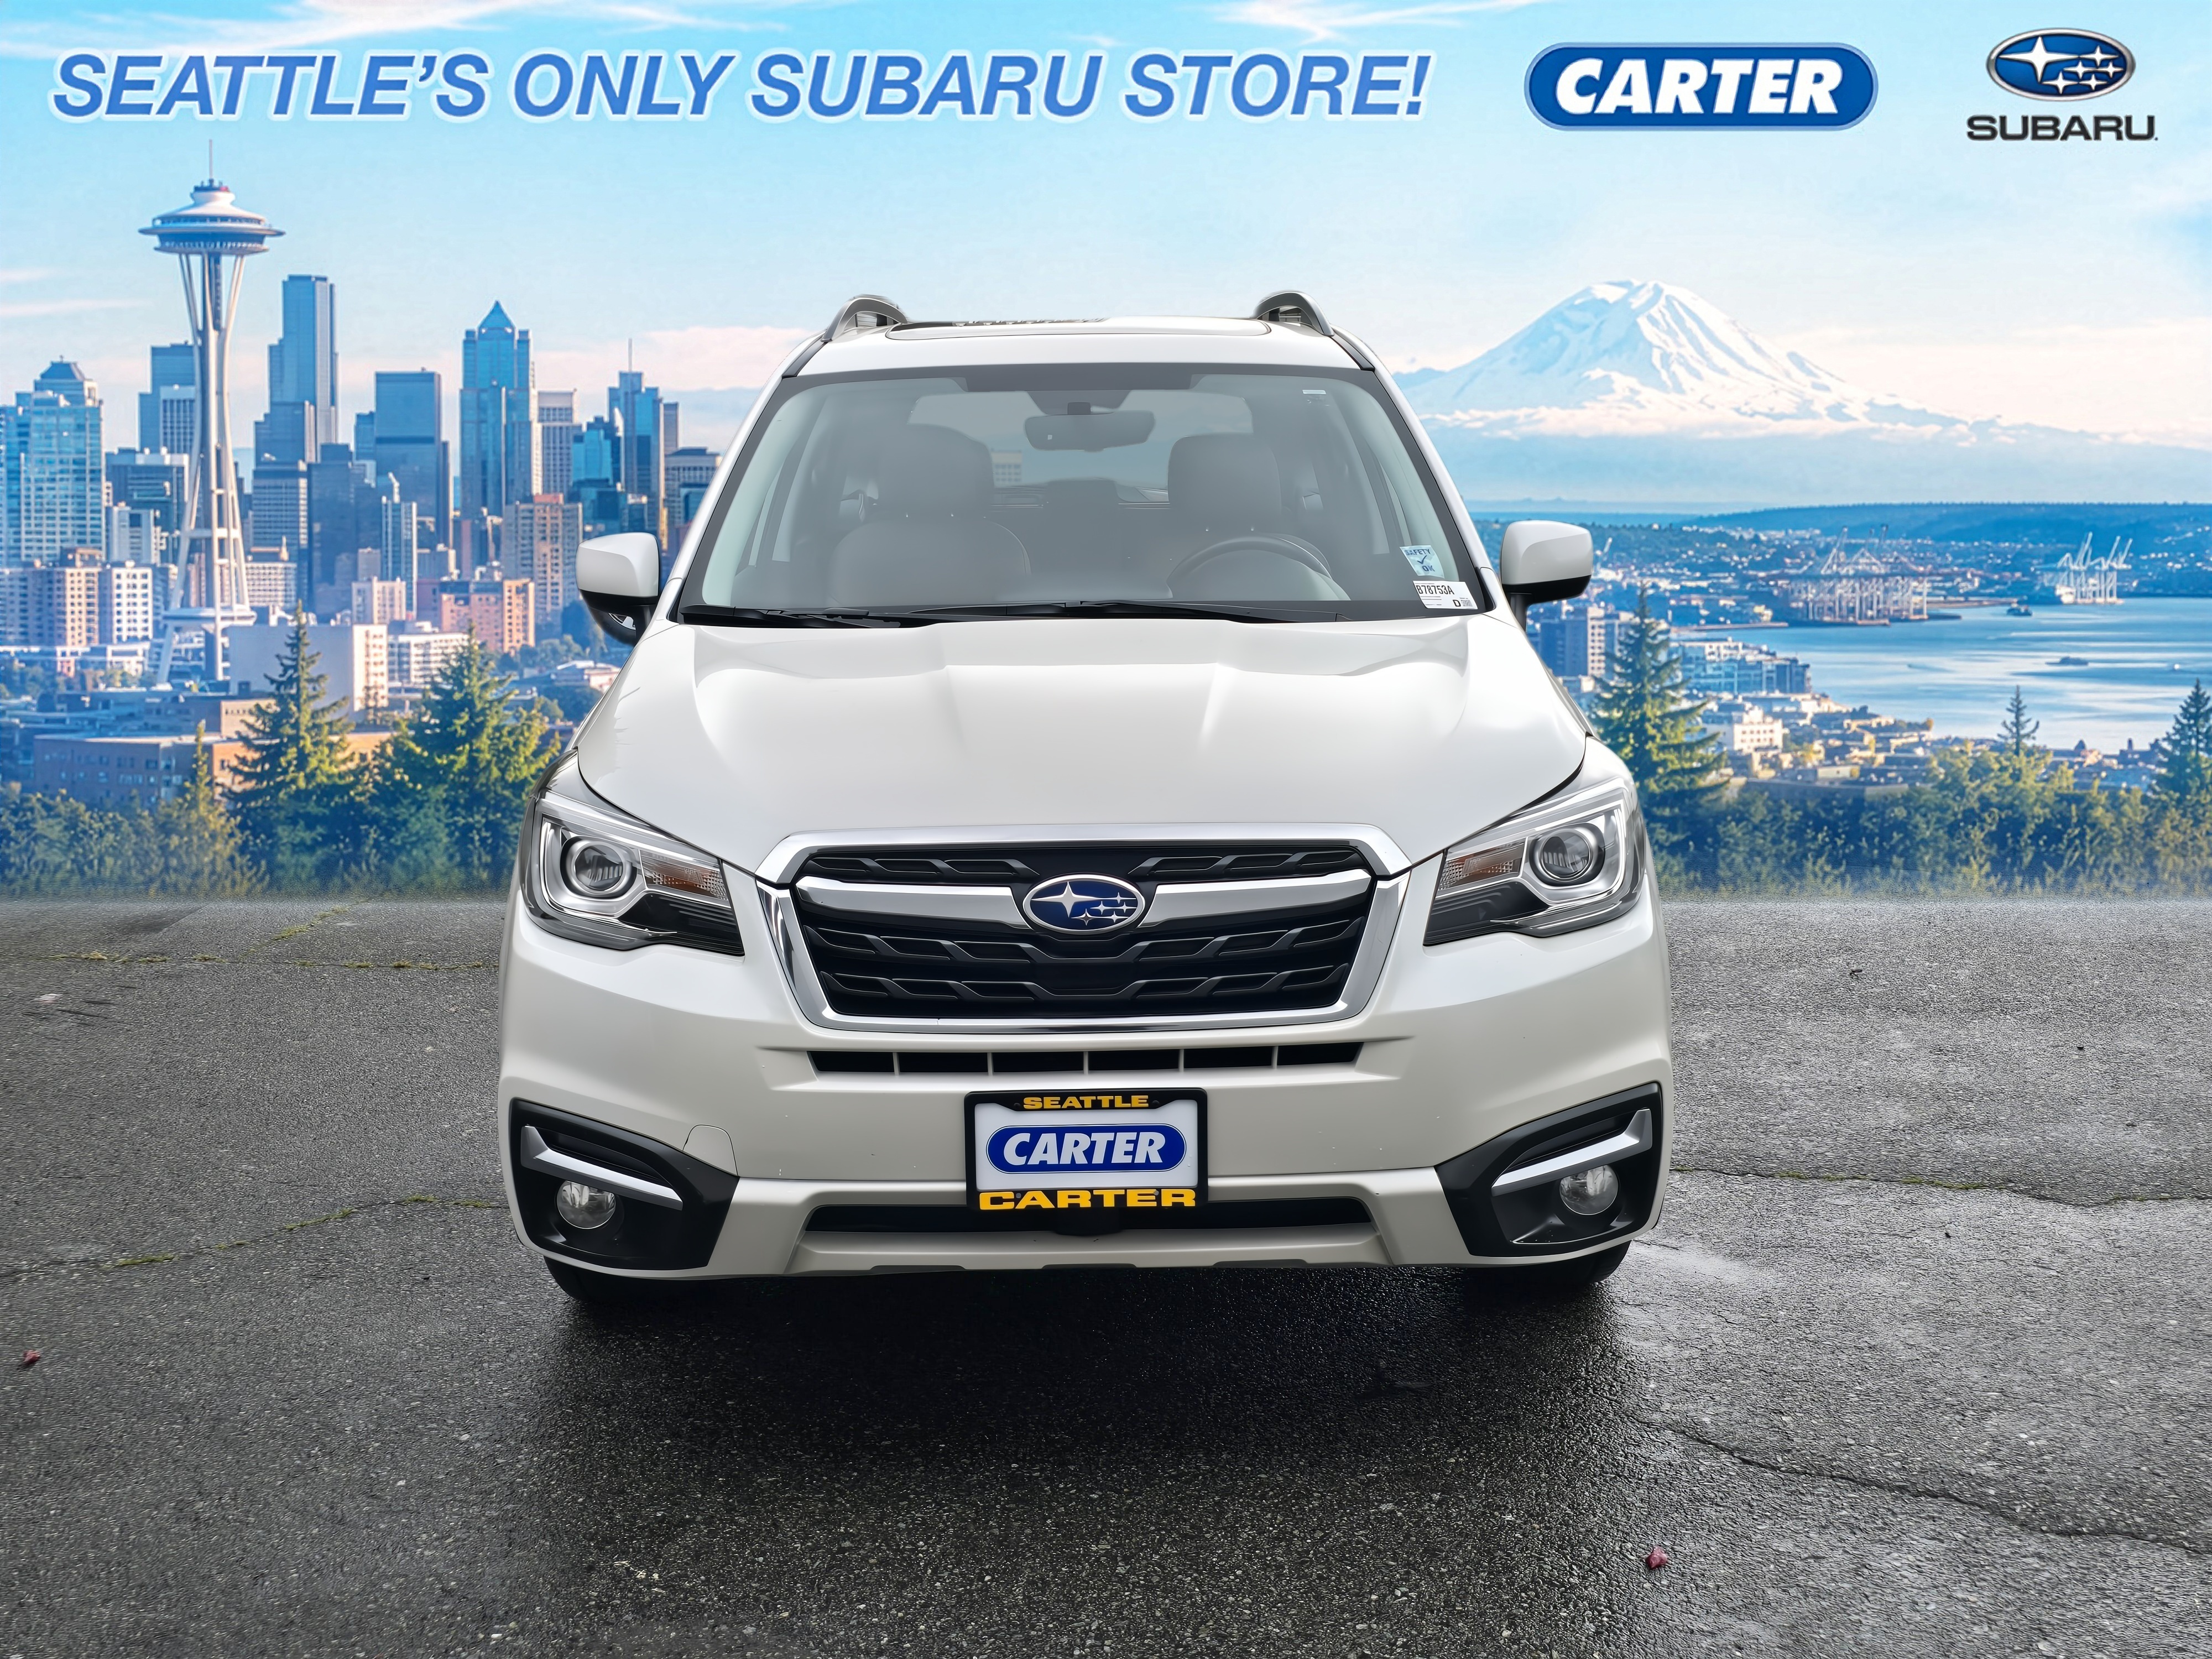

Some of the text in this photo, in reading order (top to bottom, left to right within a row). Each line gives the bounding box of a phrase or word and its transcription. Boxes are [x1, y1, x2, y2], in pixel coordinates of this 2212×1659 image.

[1416, 585, 1454, 595] B78753A
[1023, 1095, 1149, 1109] SEATTLE
[1004, 1131, 1166, 1166] CARTER
[979, 1189, 1196, 1210] CARTER
